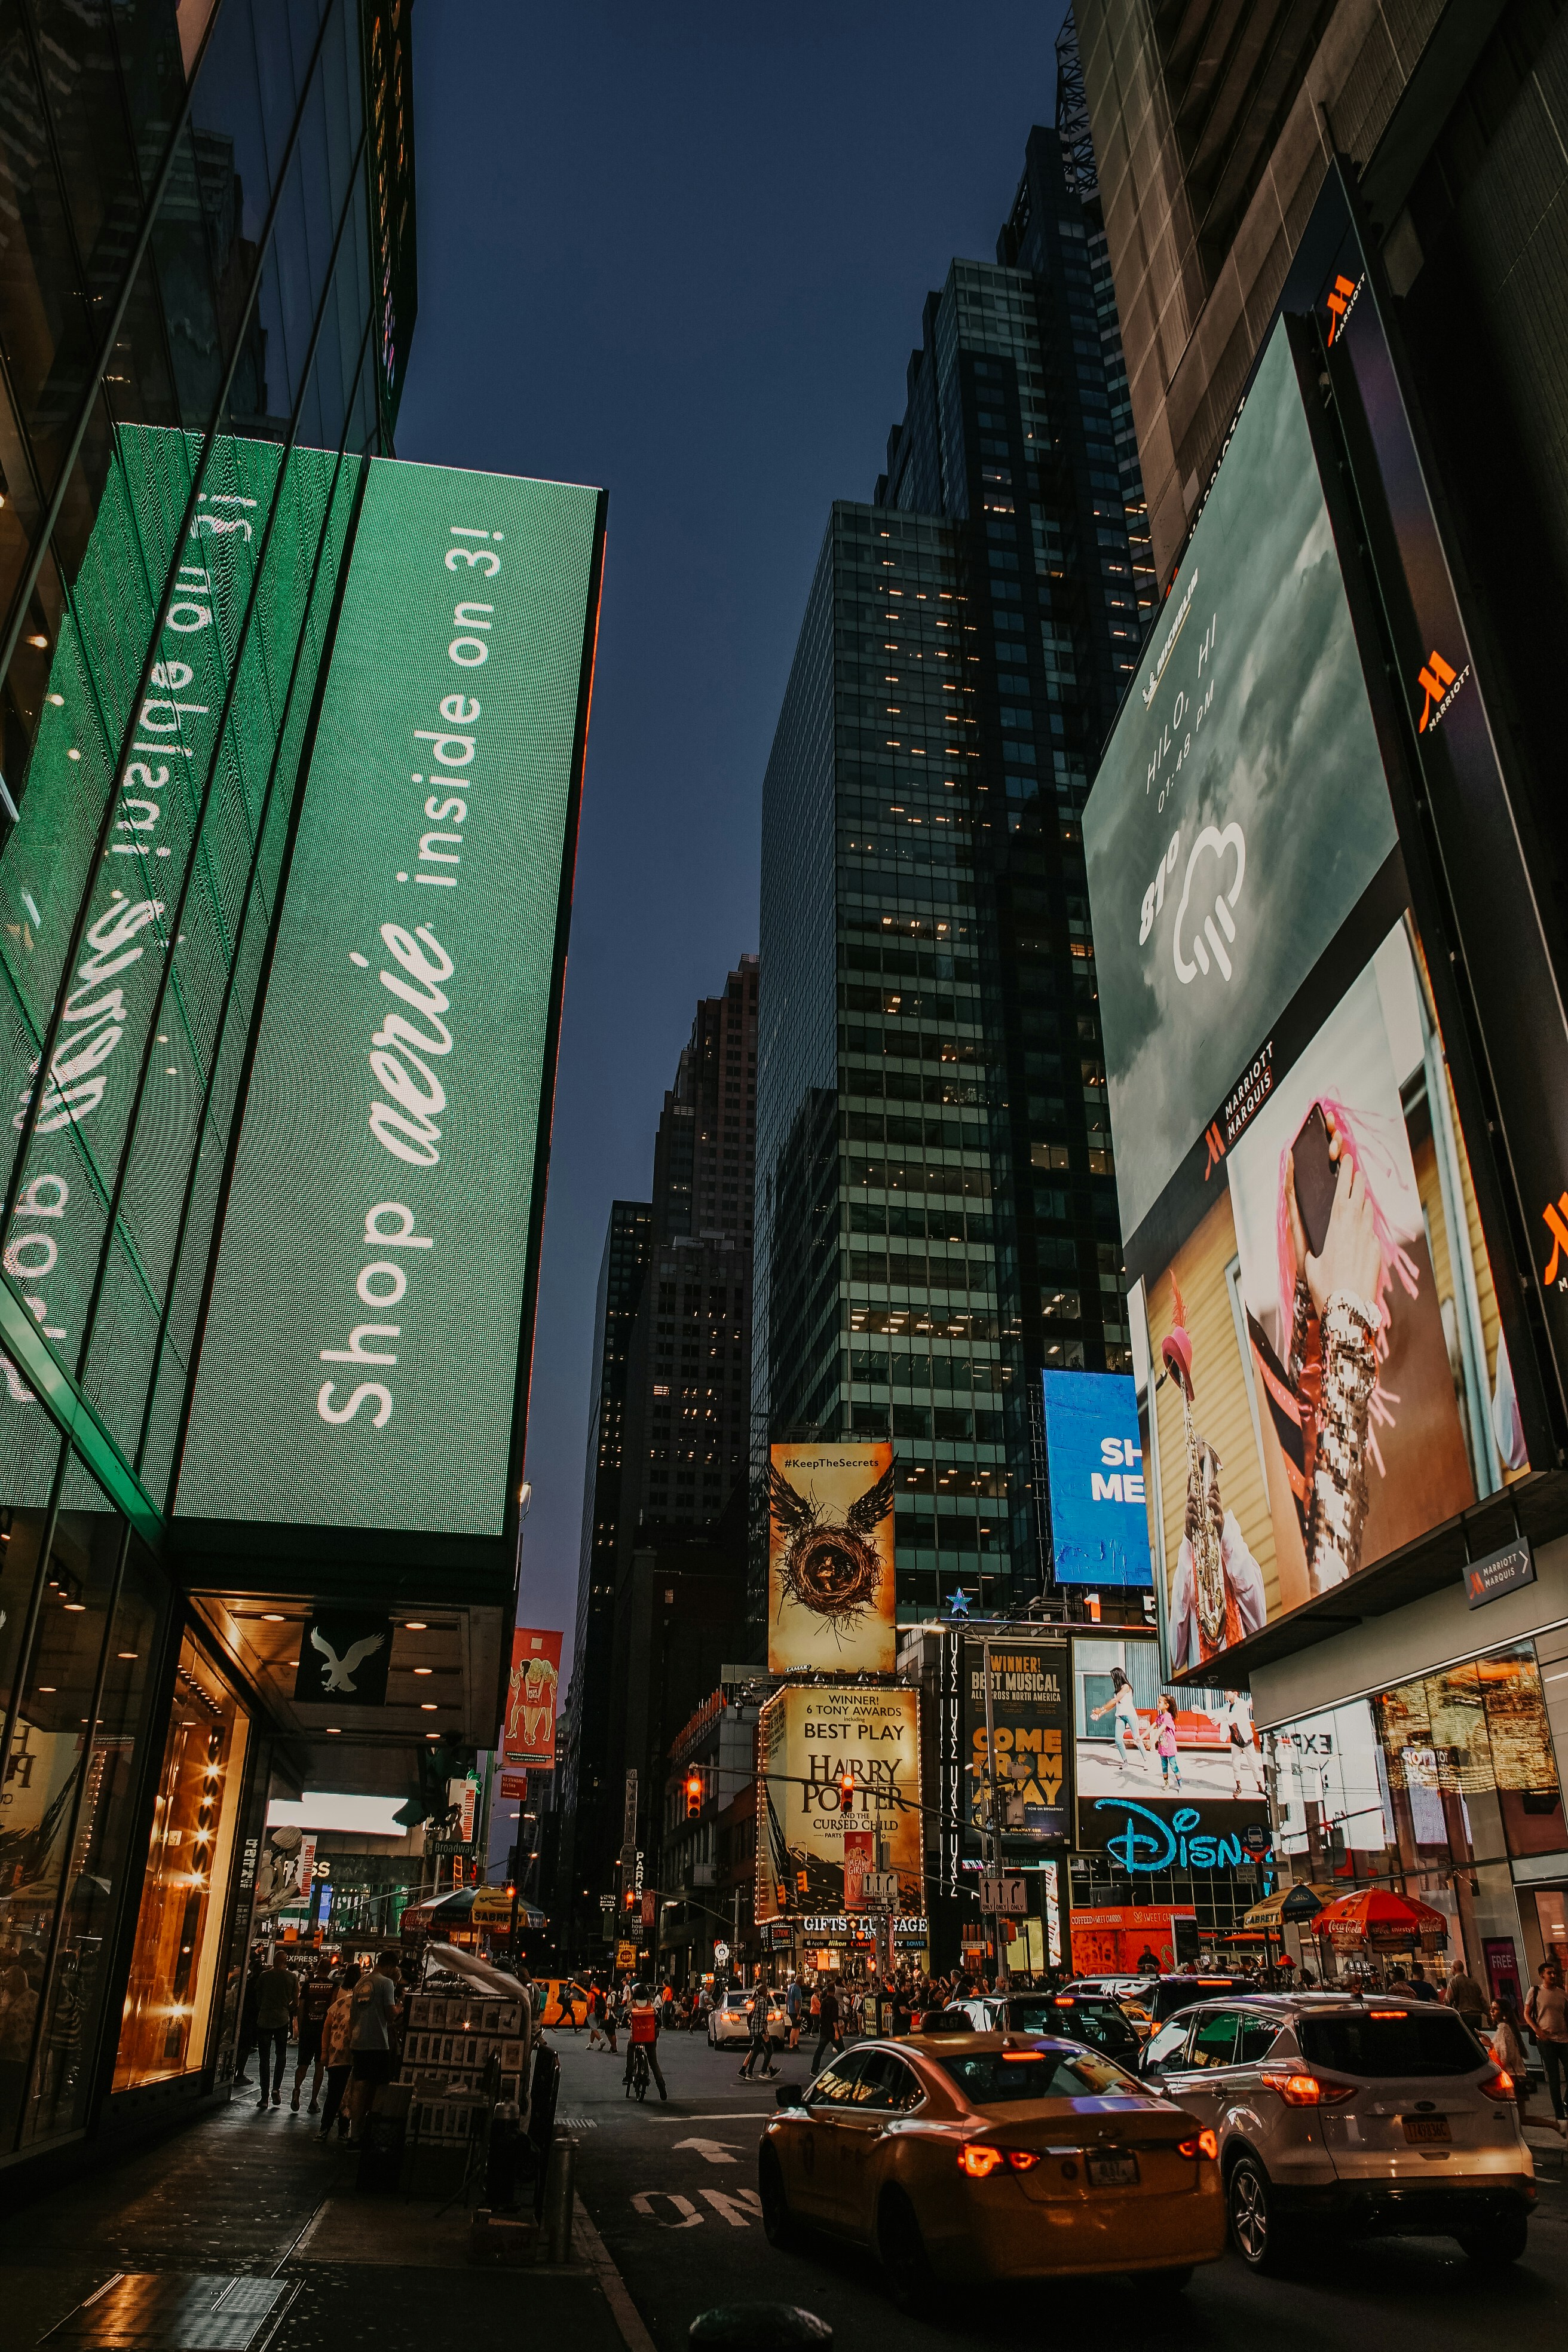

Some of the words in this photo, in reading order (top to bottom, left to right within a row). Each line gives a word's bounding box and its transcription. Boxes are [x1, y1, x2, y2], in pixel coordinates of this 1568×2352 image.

[1335, 272, 1365, 342] MARRIOTT
[445, 525, 504, 577] 3!
[1157, 568, 1198, 673] MICHELIN
[448, 602, 494, 668] on
[1146, 690, 1190, 795] HILO,
[1198, 612, 1217, 679] HI
[1429, 664, 1469, 732] MARRIOTT
[1158, 733, 1190, 813] 01:48
[1196, 679, 1214, 733] PM
[396, 693, 480, 888] inside
[348, 920, 455, 1167] aerie
[1225, 1041, 1273, 1120] MARRIOTT
[1227, 1071, 1271, 1140] MARQUIS
[317, 1201, 433, 1428] Shop
[784, 1459, 879, 1470] #KeepTheSecrets
[1483, 1553, 1517, 1576] MARRIOTT
[1485, 1567, 1515, 1588] MARQUIS
[990, 1655, 1041, 1673] WINNER!
[972, 1671, 1002, 1690] BEST
[1006, 1673, 1060, 1692] MUSICAL
[828, 1695, 879, 1705] WINNER!
[971, 1690, 983, 1699] ALL
[985, 1691, 1010, 1700] CROSS
[1012, 1692, 1031, 1701] NORTH
[1033, 1692, 1061, 1702] AMERICA
[807, 1705, 812, 1714] 6
[816, 1705, 849, 1715] TONY
[853, 1707, 902, 1717] AWARDS
[804, 1723, 851, 1739] BEST
[858, 1725, 905, 1740] PLAY
[972, 1726, 1062, 1753] COME
[808, 1754, 902, 1786] HARRY
[972, 1752, 1062, 1779] FROM
[465, 1789, 475, 1814] PRETTY
[801, 1783, 910, 1813] POTER
[463, 1815, 473, 1840] WOMAN
[813, 1819, 858, 1830] CURSED
[862, 1820, 898, 1830] CHILD
[304, 1845, 315, 1868] PRETTY
[435, 1842, 474, 1856] Broadway
[635, 1852, 644, 1889] PARK
[1010, 1858, 1039, 1867] Broadway
[301, 1872, 312, 1897] WOMAN
[474, 1912, 522, 1922] SABRET
[804, 1918, 847, 1931] GIFTS
[859, 1919, 927, 1932] LUGAGE
[1071, 1916, 1093, 1925] COFFEED
[1144, 1913, 1160, 1922] SWEET
[1245, 1913, 1279, 1925] SABRETT
[1492, 1955, 1513, 1968] FREE
